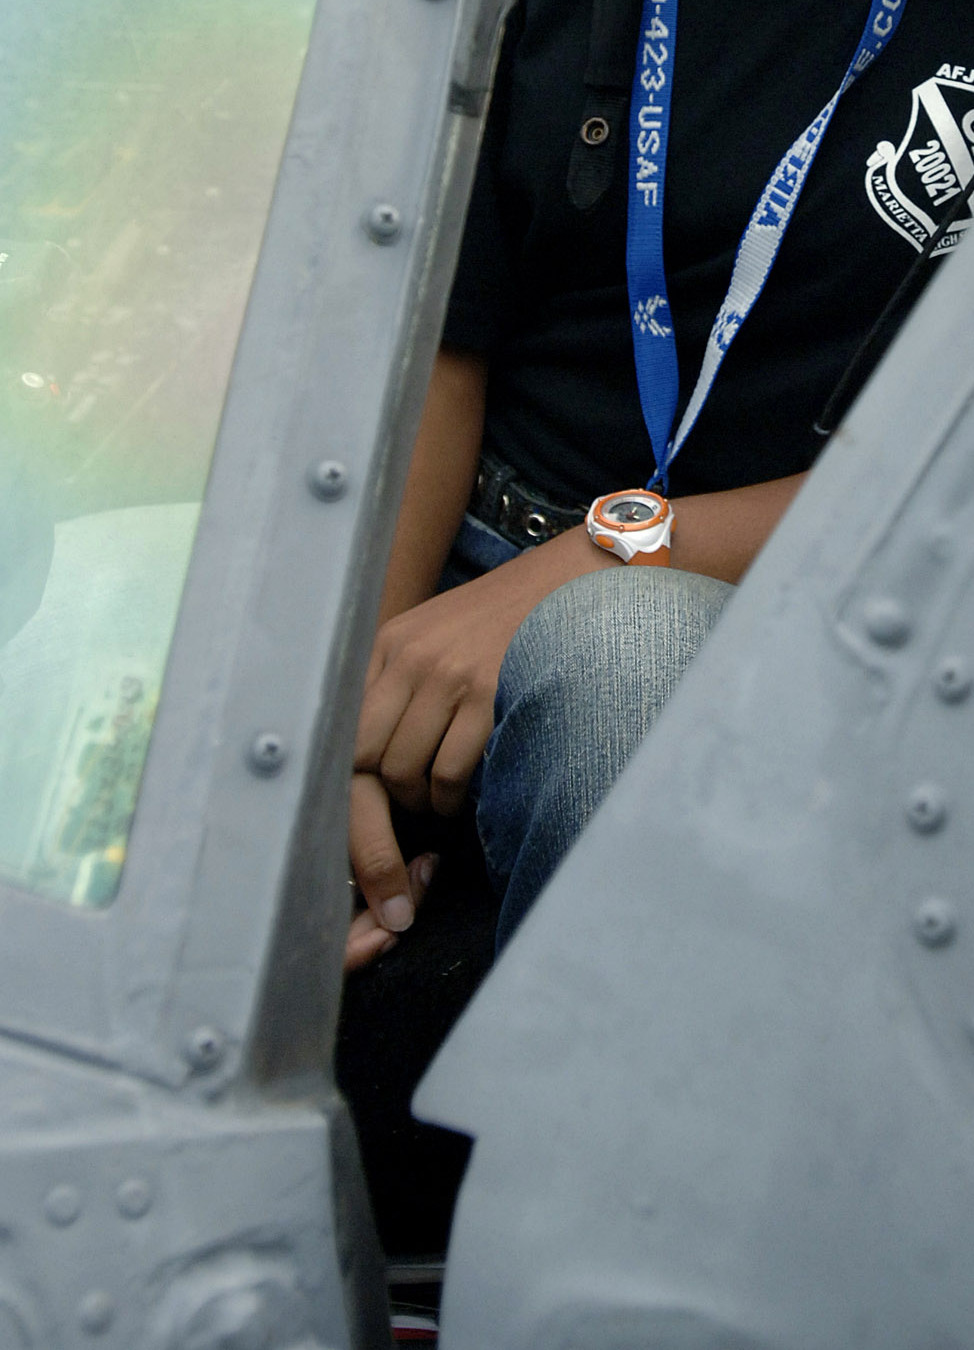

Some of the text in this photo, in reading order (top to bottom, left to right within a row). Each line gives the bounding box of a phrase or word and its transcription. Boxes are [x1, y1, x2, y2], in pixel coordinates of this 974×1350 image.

[908, 139, 963, 207] 20021
[871, 175, 959, 250] MARIETTA IGH
